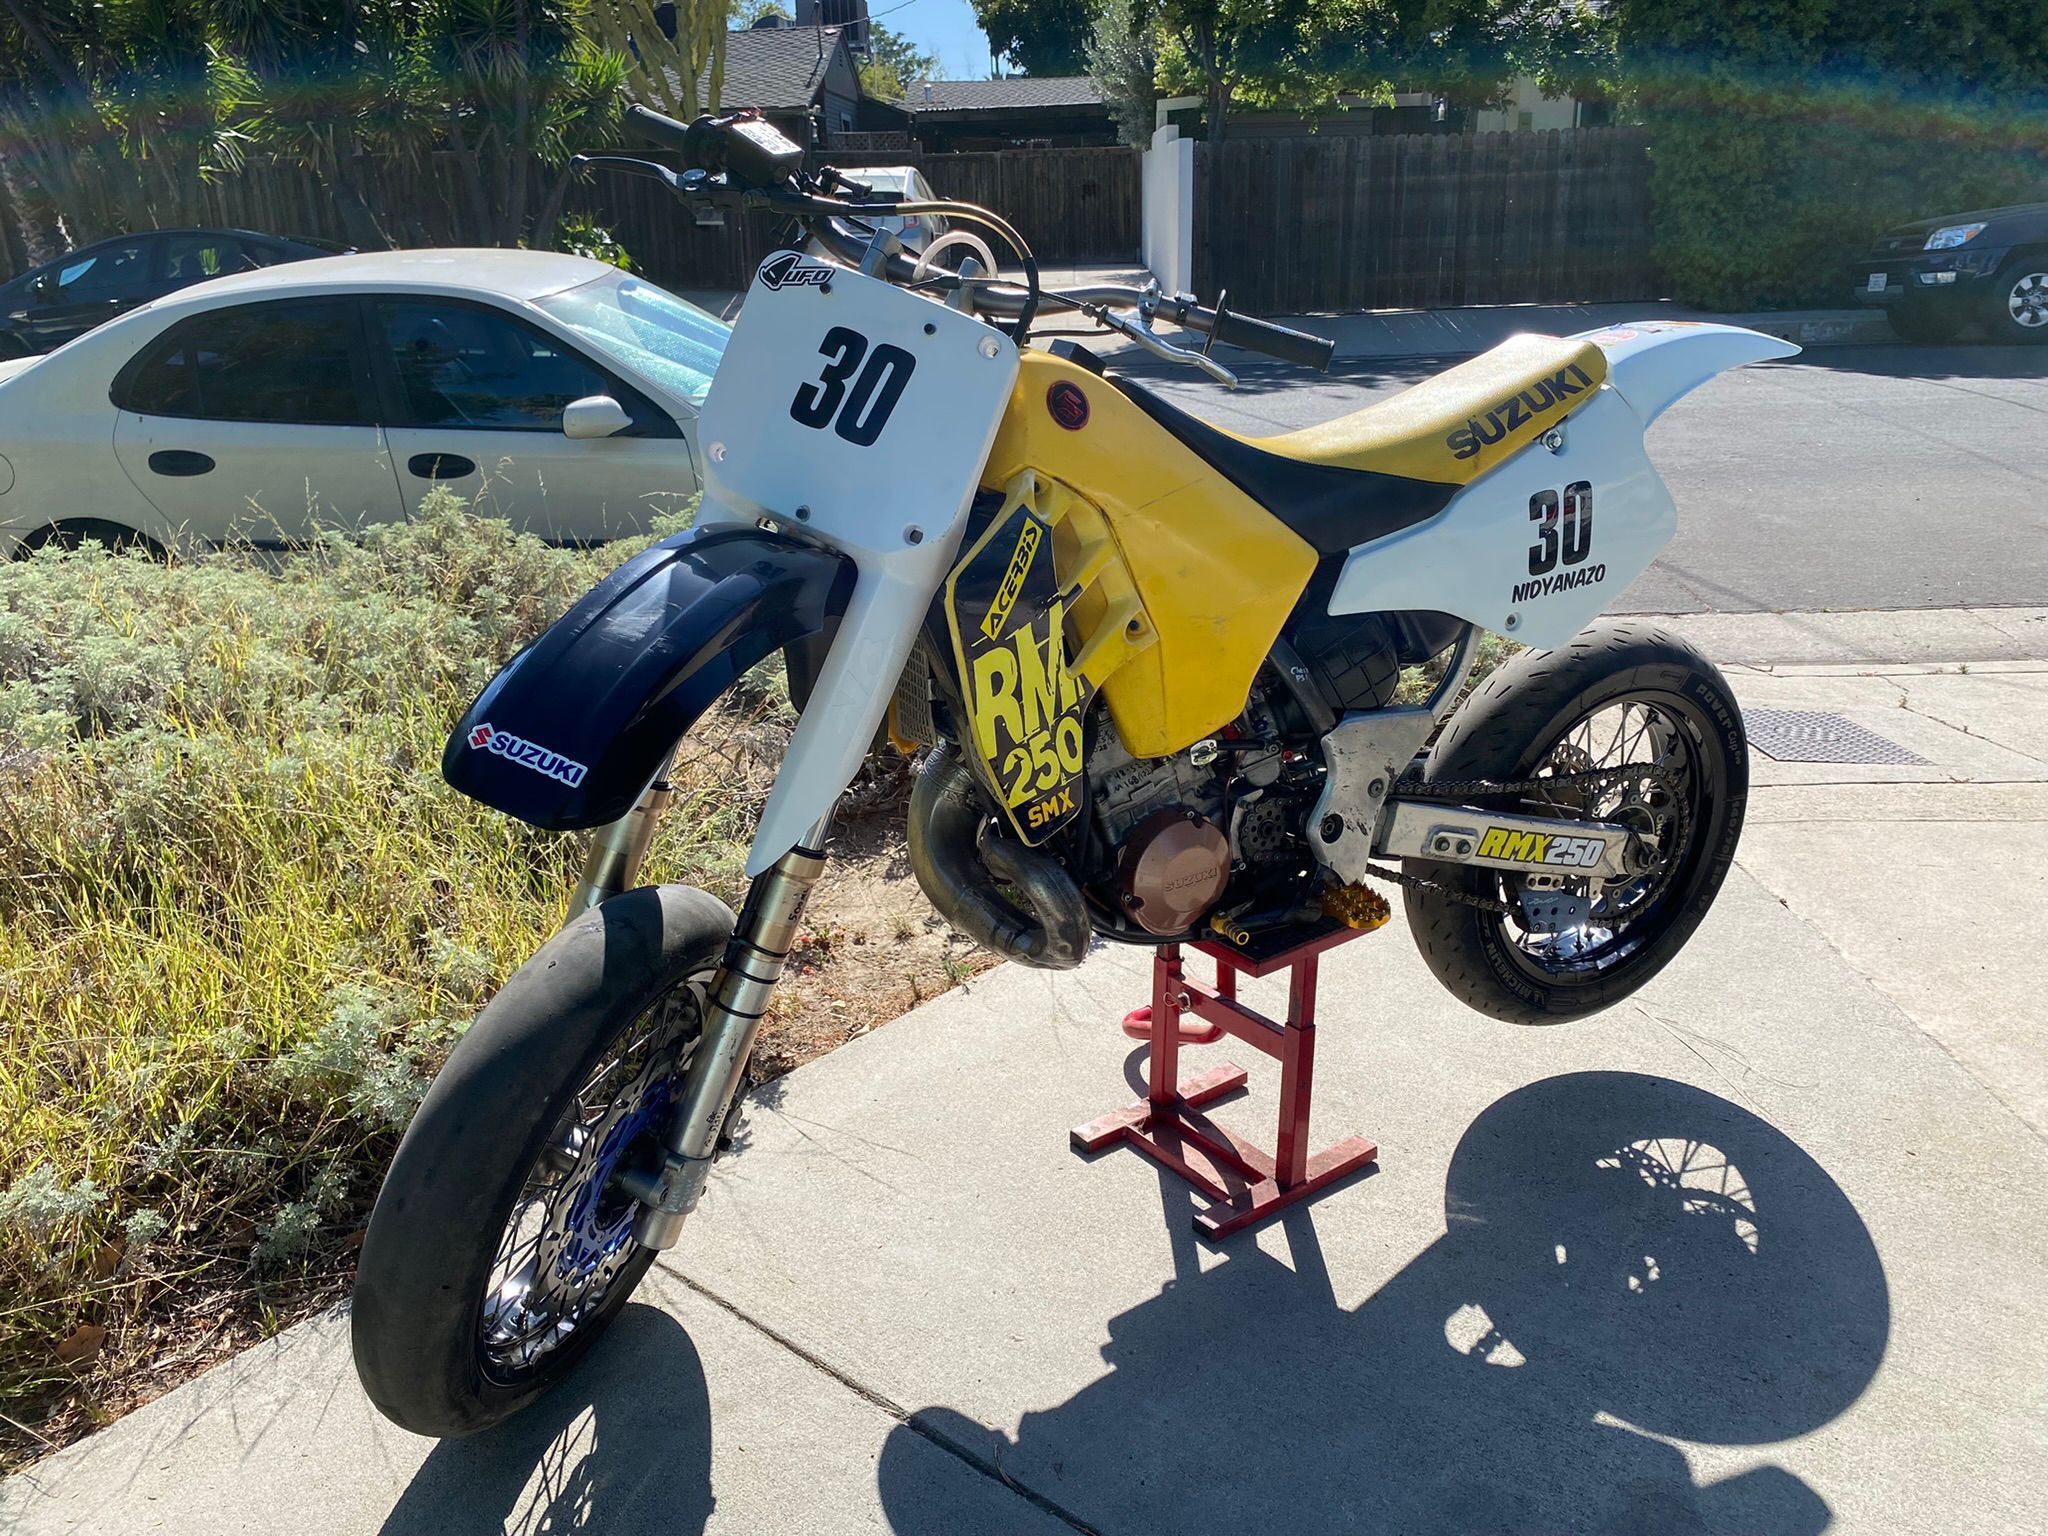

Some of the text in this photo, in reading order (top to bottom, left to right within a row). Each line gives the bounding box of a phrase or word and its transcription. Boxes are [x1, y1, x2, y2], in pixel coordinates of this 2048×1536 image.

[781, 269, 833, 282] UFO
[790, 326, 917, 447] 30
[1446, 363, 1594, 460] SUZUKI
[1528, 480, 1593, 576] 30
[990, 526, 1038, 635] ACERBIS
[1511, 563, 1606, 604] NIDYANAZO
[973, 600, 1085, 759] RM
[491, 734, 584, 785] SUZUKI
[1003, 716, 1082, 808] 250
[1028, 787, 1076, 828] SMX
[1164, 867, 1217, 892] SUZUKI
[1486, 942, 1532, 999] MICHELIN
